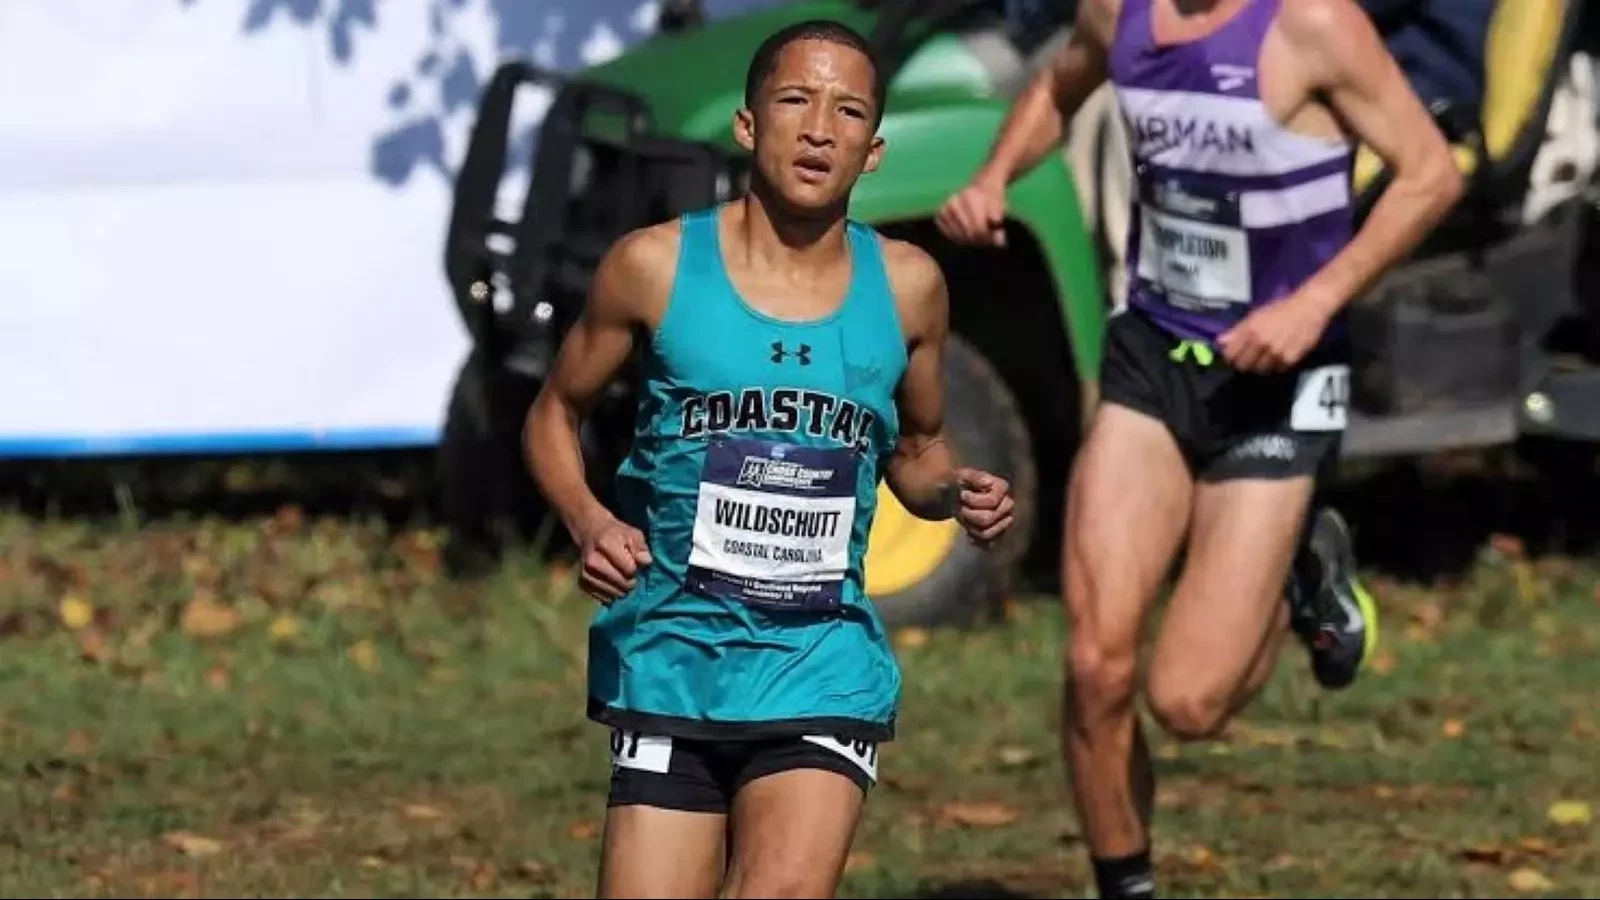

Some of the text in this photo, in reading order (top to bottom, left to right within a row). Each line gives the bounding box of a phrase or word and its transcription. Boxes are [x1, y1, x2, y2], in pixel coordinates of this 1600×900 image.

[682, 387, 875, 447] COASTAL
[714, 498, 841, 538] WILDSCHUTT
[723, 538, 823, 563] COASTAL CAROLINA
